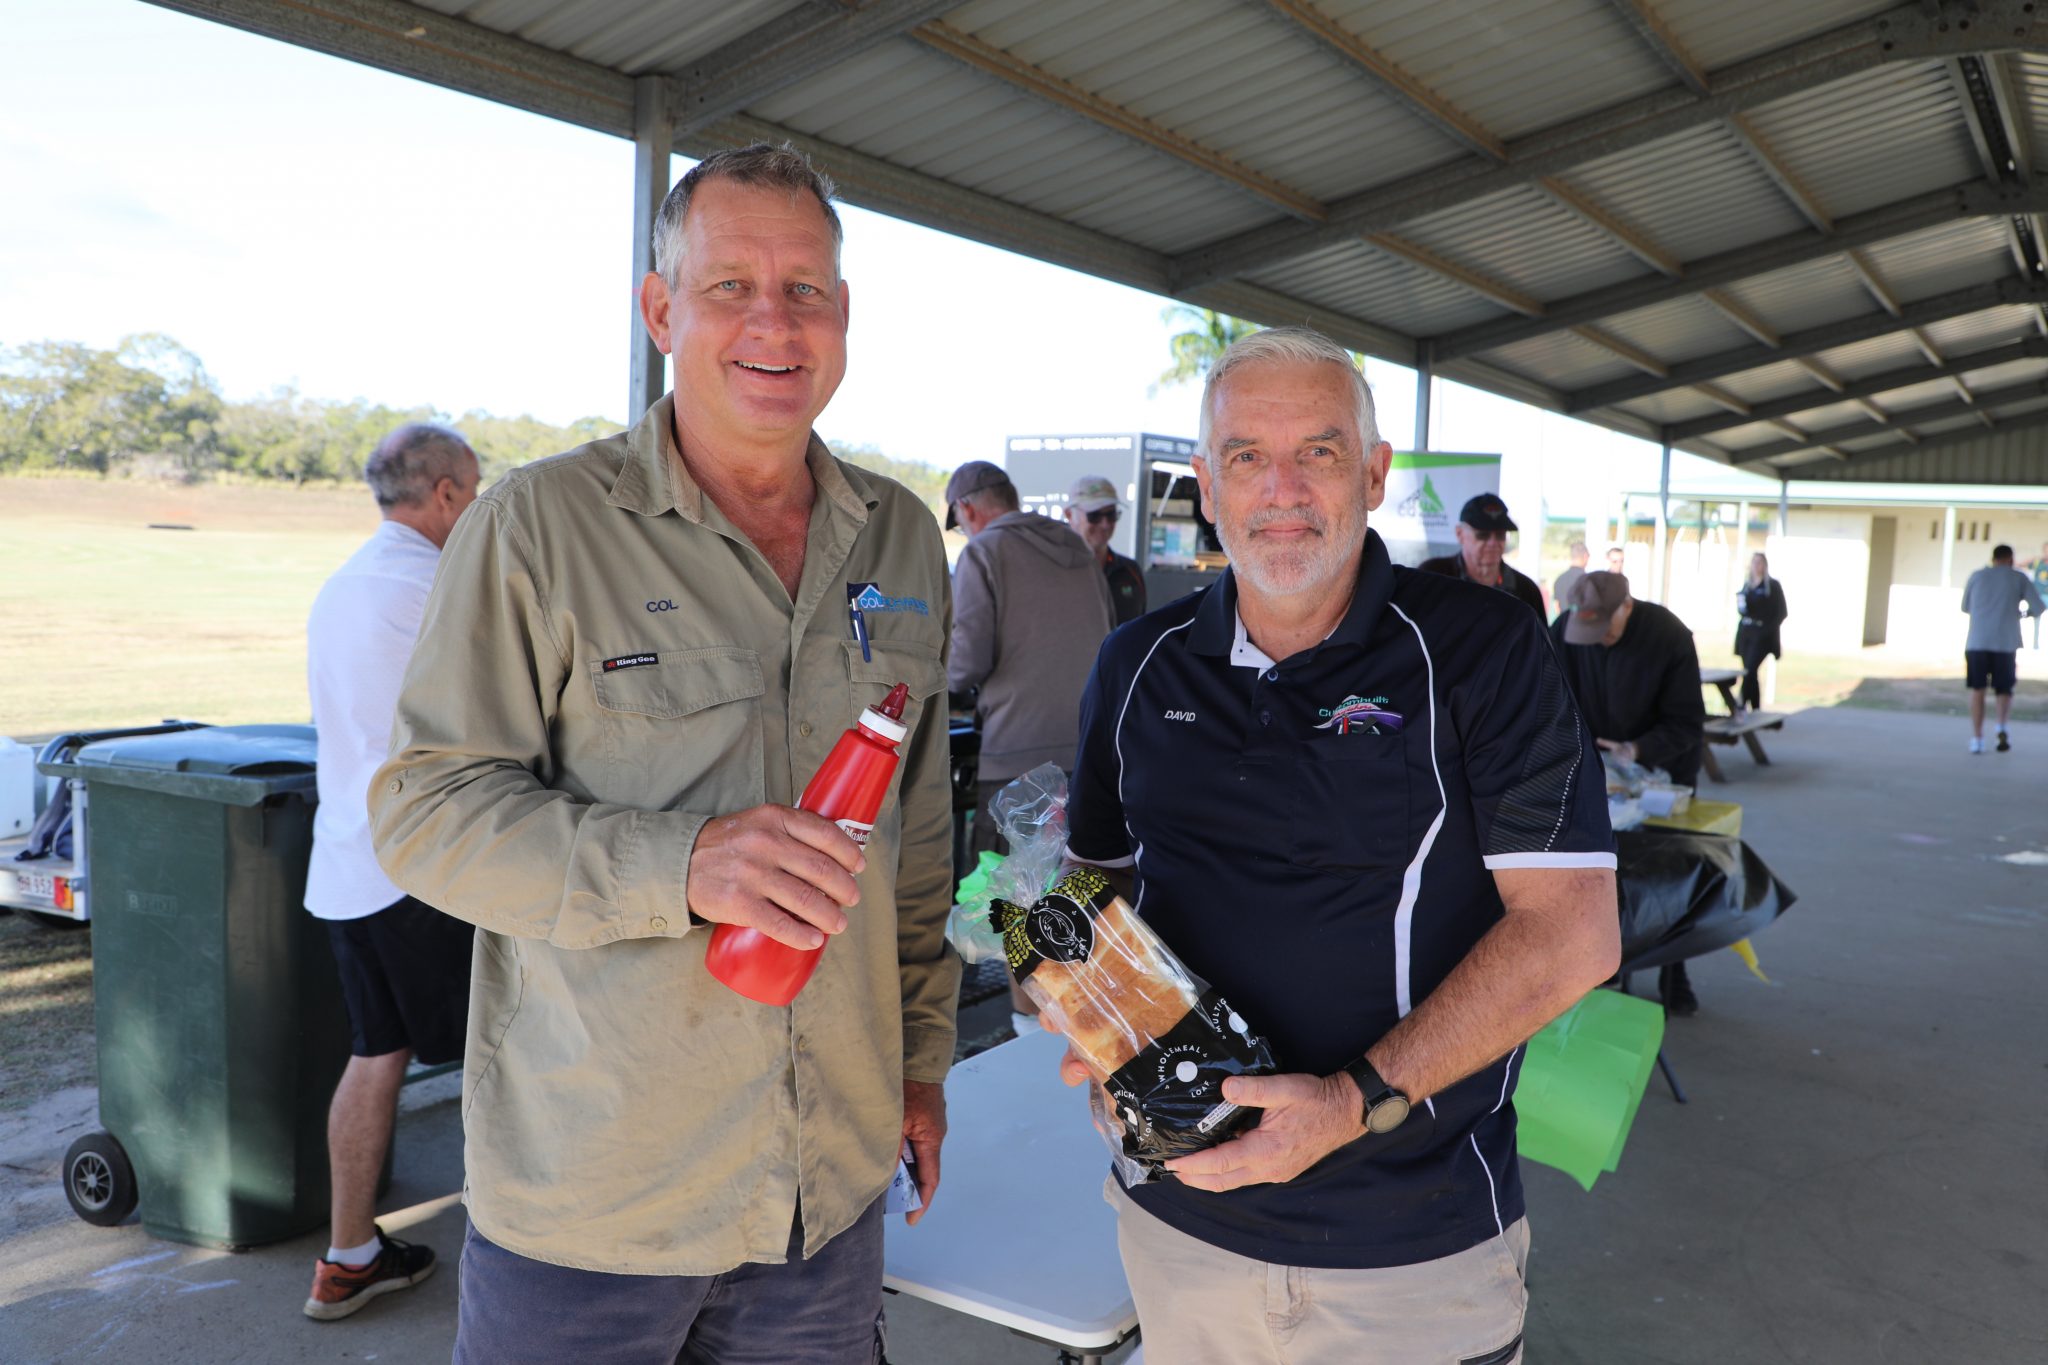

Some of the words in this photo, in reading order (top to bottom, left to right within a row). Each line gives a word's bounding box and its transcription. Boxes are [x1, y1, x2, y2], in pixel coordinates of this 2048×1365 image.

[646, 599, 679, 613] COL
[860, 597, 885, 609] COL
[1164, 710, 1196, 722] DAVID
[1157, 1044, 1201, 1083] WHOLEMEAL
[1191, 1080, 1211, 1098] LOAF
[1144, 1116, 1153, 1137] LOAF
